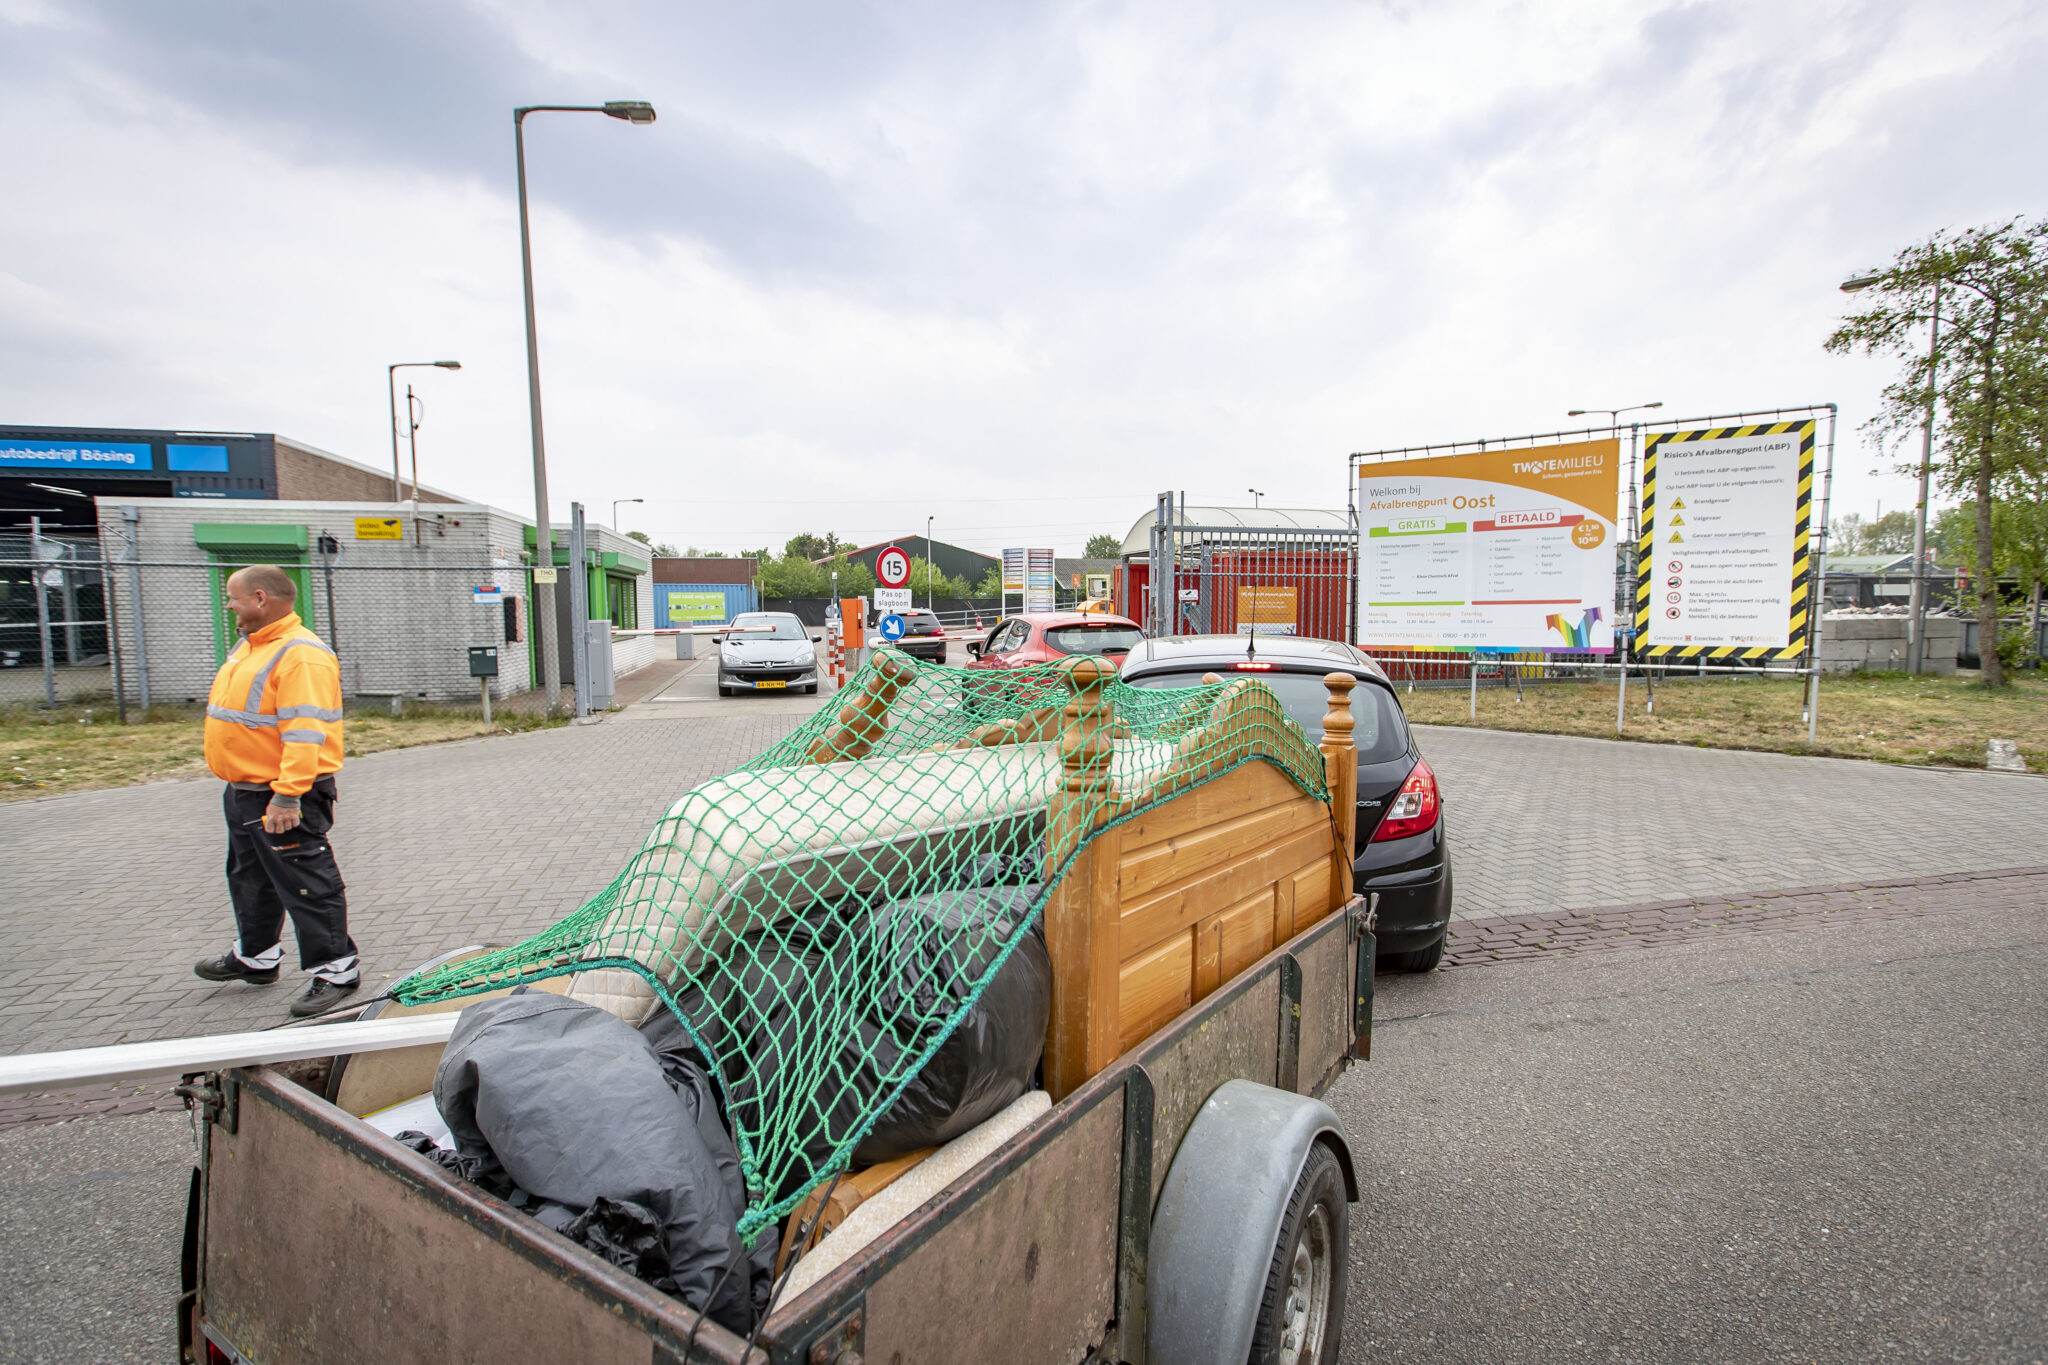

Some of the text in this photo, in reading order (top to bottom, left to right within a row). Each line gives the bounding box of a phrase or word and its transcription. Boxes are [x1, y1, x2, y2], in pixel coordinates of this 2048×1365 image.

[1695, 446, 1762, 457] Afvalbrengpunt
[1764, 442, 1791, 452] (ABP)
[80, 449, 135, 464] Bösing
[1370, 485, 1421, 498] Welkom bij
[1370, 494, 1496, 511] Afvalbrengpunt Oost
[1398, 519, 1436, 530] GRATIS
[1500, 512, 1555, 524] BETAALD
[886, 560, 903, 576] 15
[881, 590, 893, 598] Pas
[878, 600, 909, 608] slagboom
